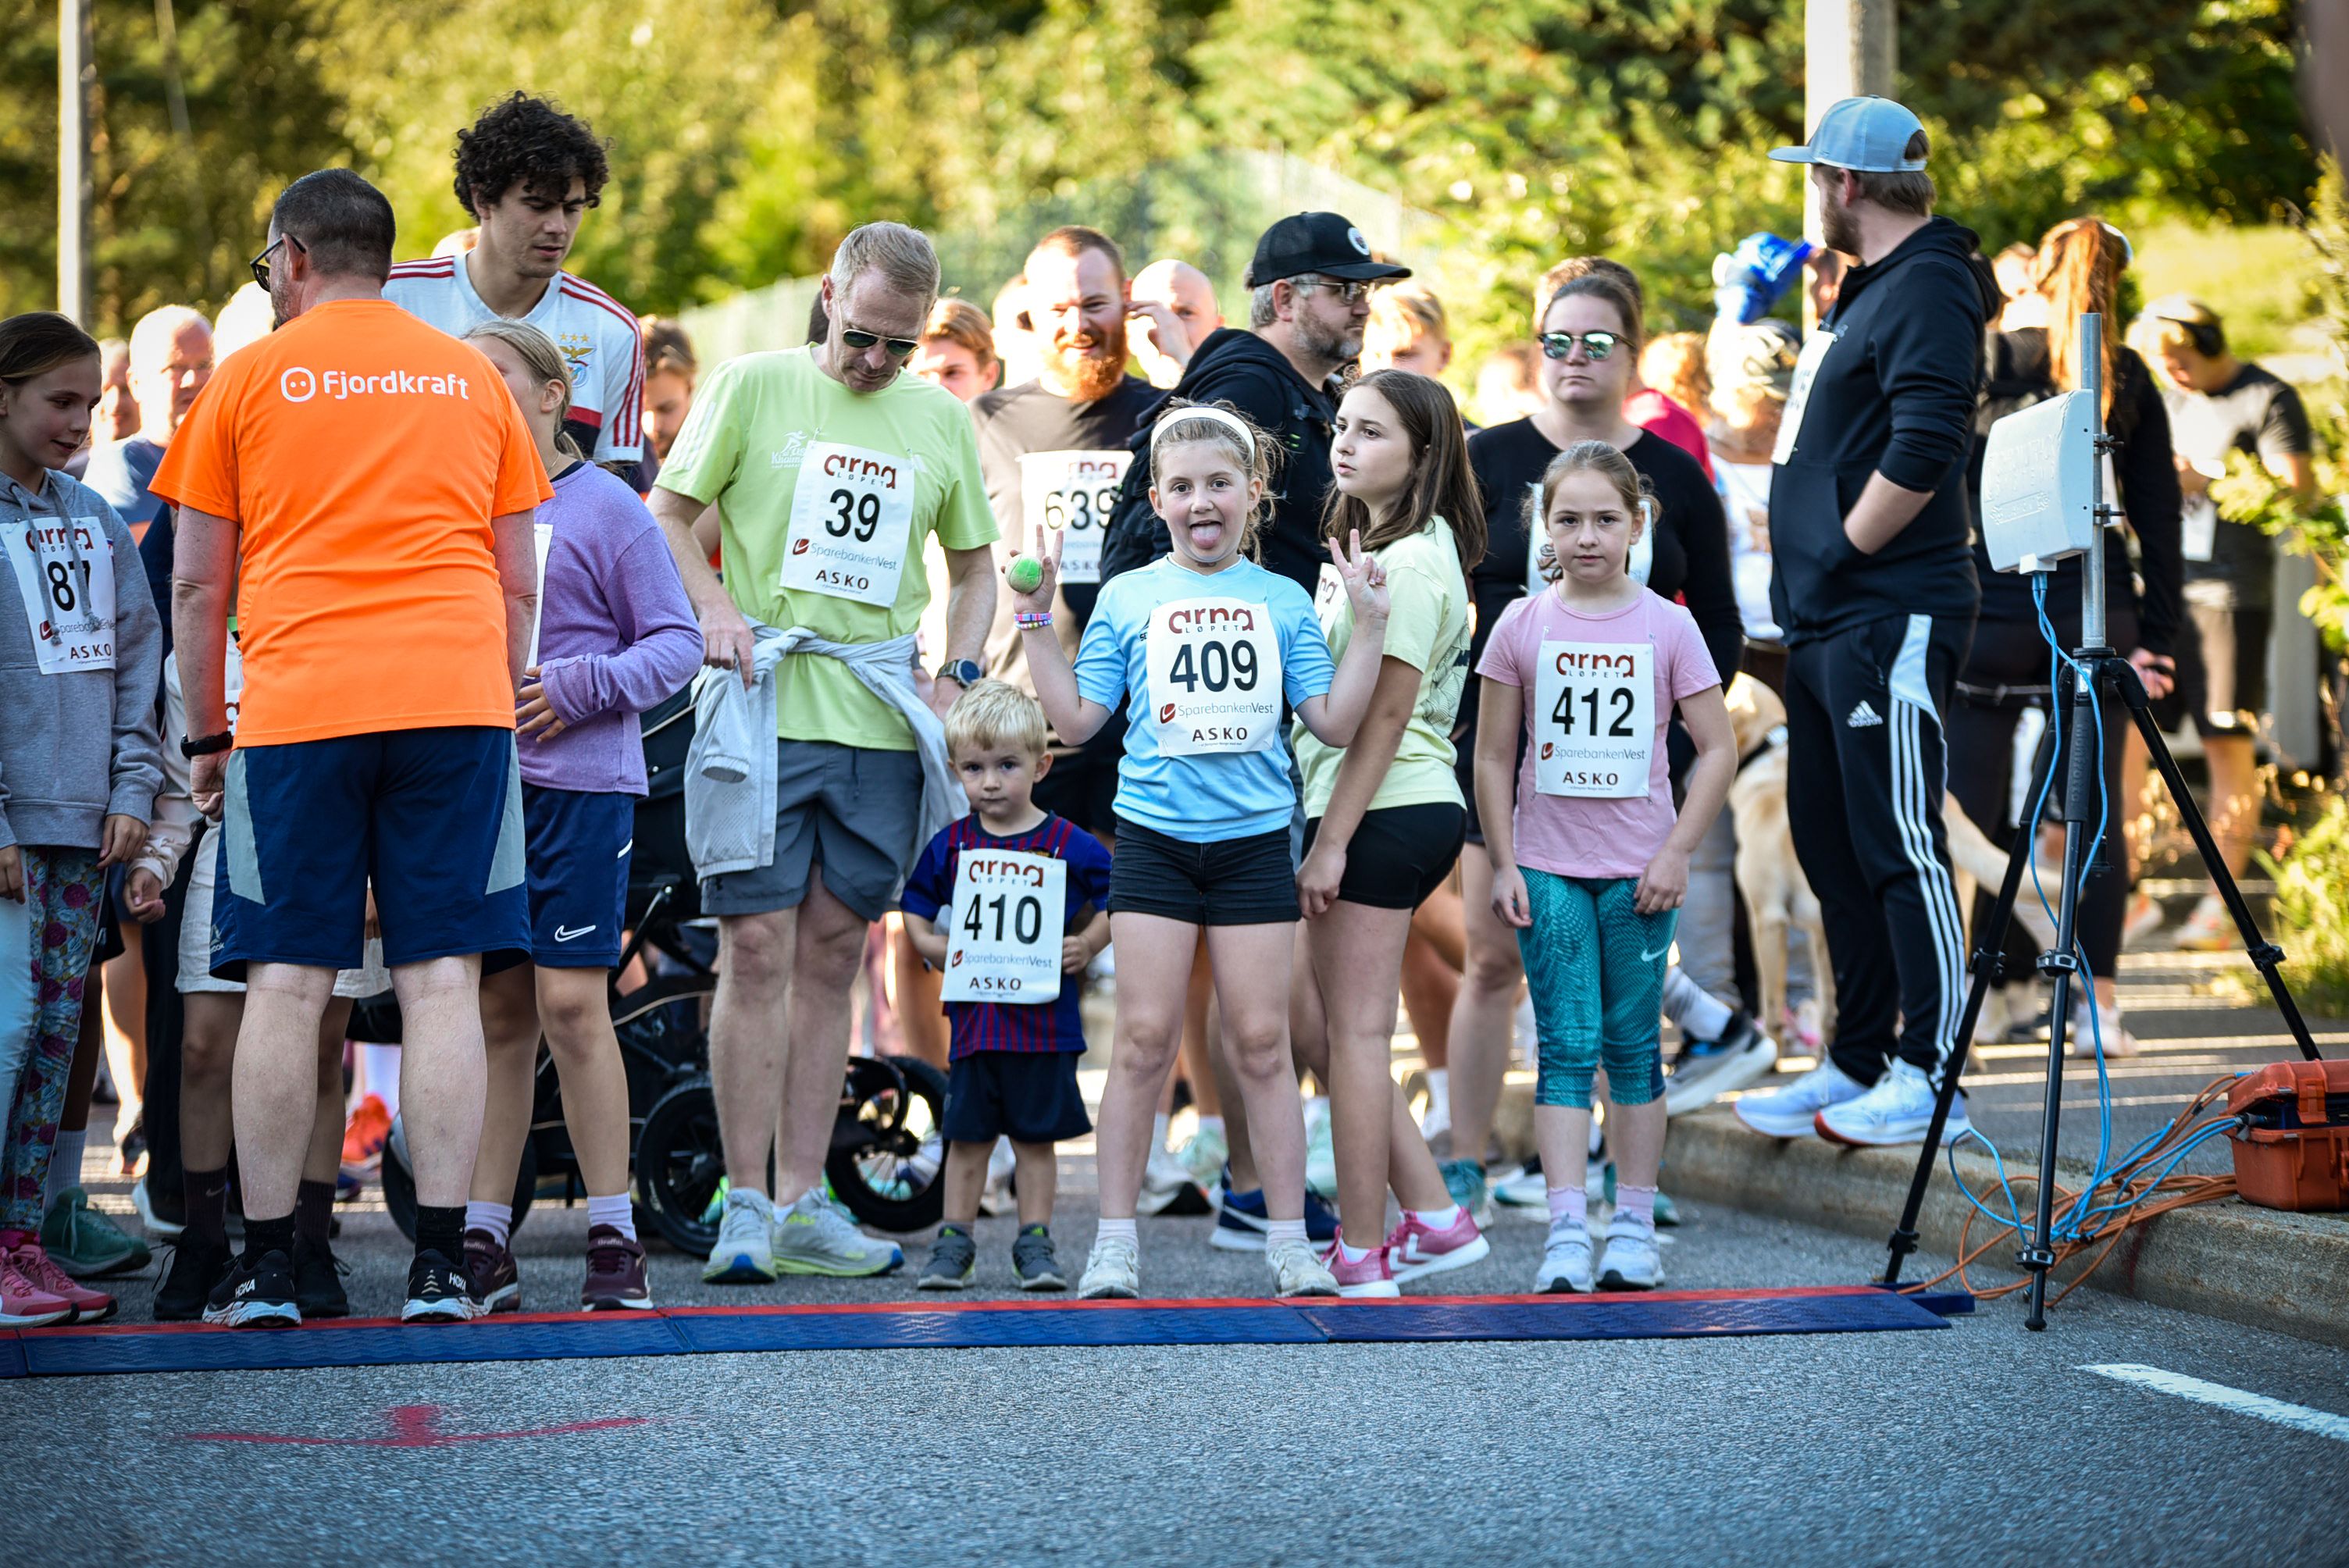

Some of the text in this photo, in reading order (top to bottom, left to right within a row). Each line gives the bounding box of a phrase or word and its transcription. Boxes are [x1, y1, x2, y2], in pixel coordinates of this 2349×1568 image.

[323, 370, 469, 400] Fjordkraft
[824, 454, 896, 489] arna
[837, 472, 884, 486] LØPET
[825, 488, 881, 543] 39
[1046, 487, 1112, 530] 639
[41, 543, 83, 553] LØPT
[815, 569, 869, 590] ASKO
[1168, 608, 1255, 633] arna
[1185, 625, 1240, 633] LØPET
[70, 643, 112, 660] ASKO
[1170, 640, 1258, 693] 409
[1556, 652, 1634, 678] arna
[1552, 686, 1635, 737] 412
[1192, 727, 1248, 742] ASKO
[1563, 772, 1619, 786] ASKO
[969, 860, 1043, 888] arna
[978, 877, 1028, 886] LØPET
[964, 893, 1042, 945] 410
[969, 977, 1021, 991] ASKO
[235, 1278, 255, 1298] HOKA
